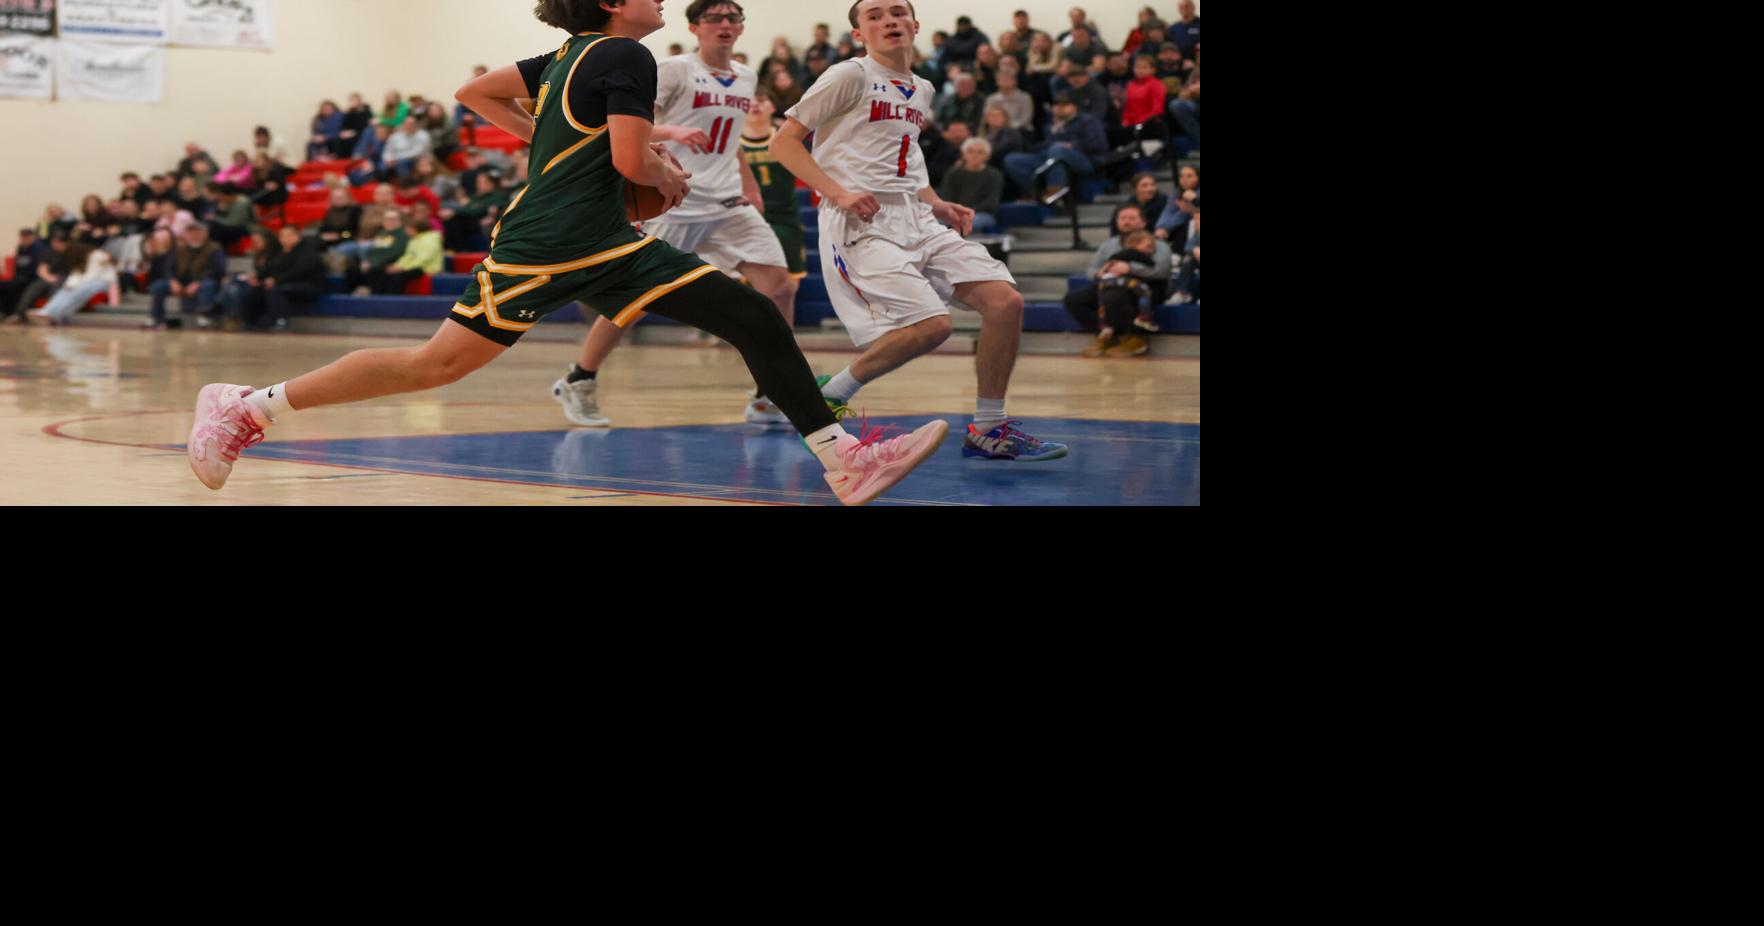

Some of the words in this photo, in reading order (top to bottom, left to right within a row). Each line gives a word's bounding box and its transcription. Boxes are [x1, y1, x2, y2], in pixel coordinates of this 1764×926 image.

[692, 91, 721, 109] MILL
[869, 99, 904, 122] MILL
[707, 116, 734, 154] 11
[897, 134, 911, 177] 1
[759, 166, 771, 185] 1
